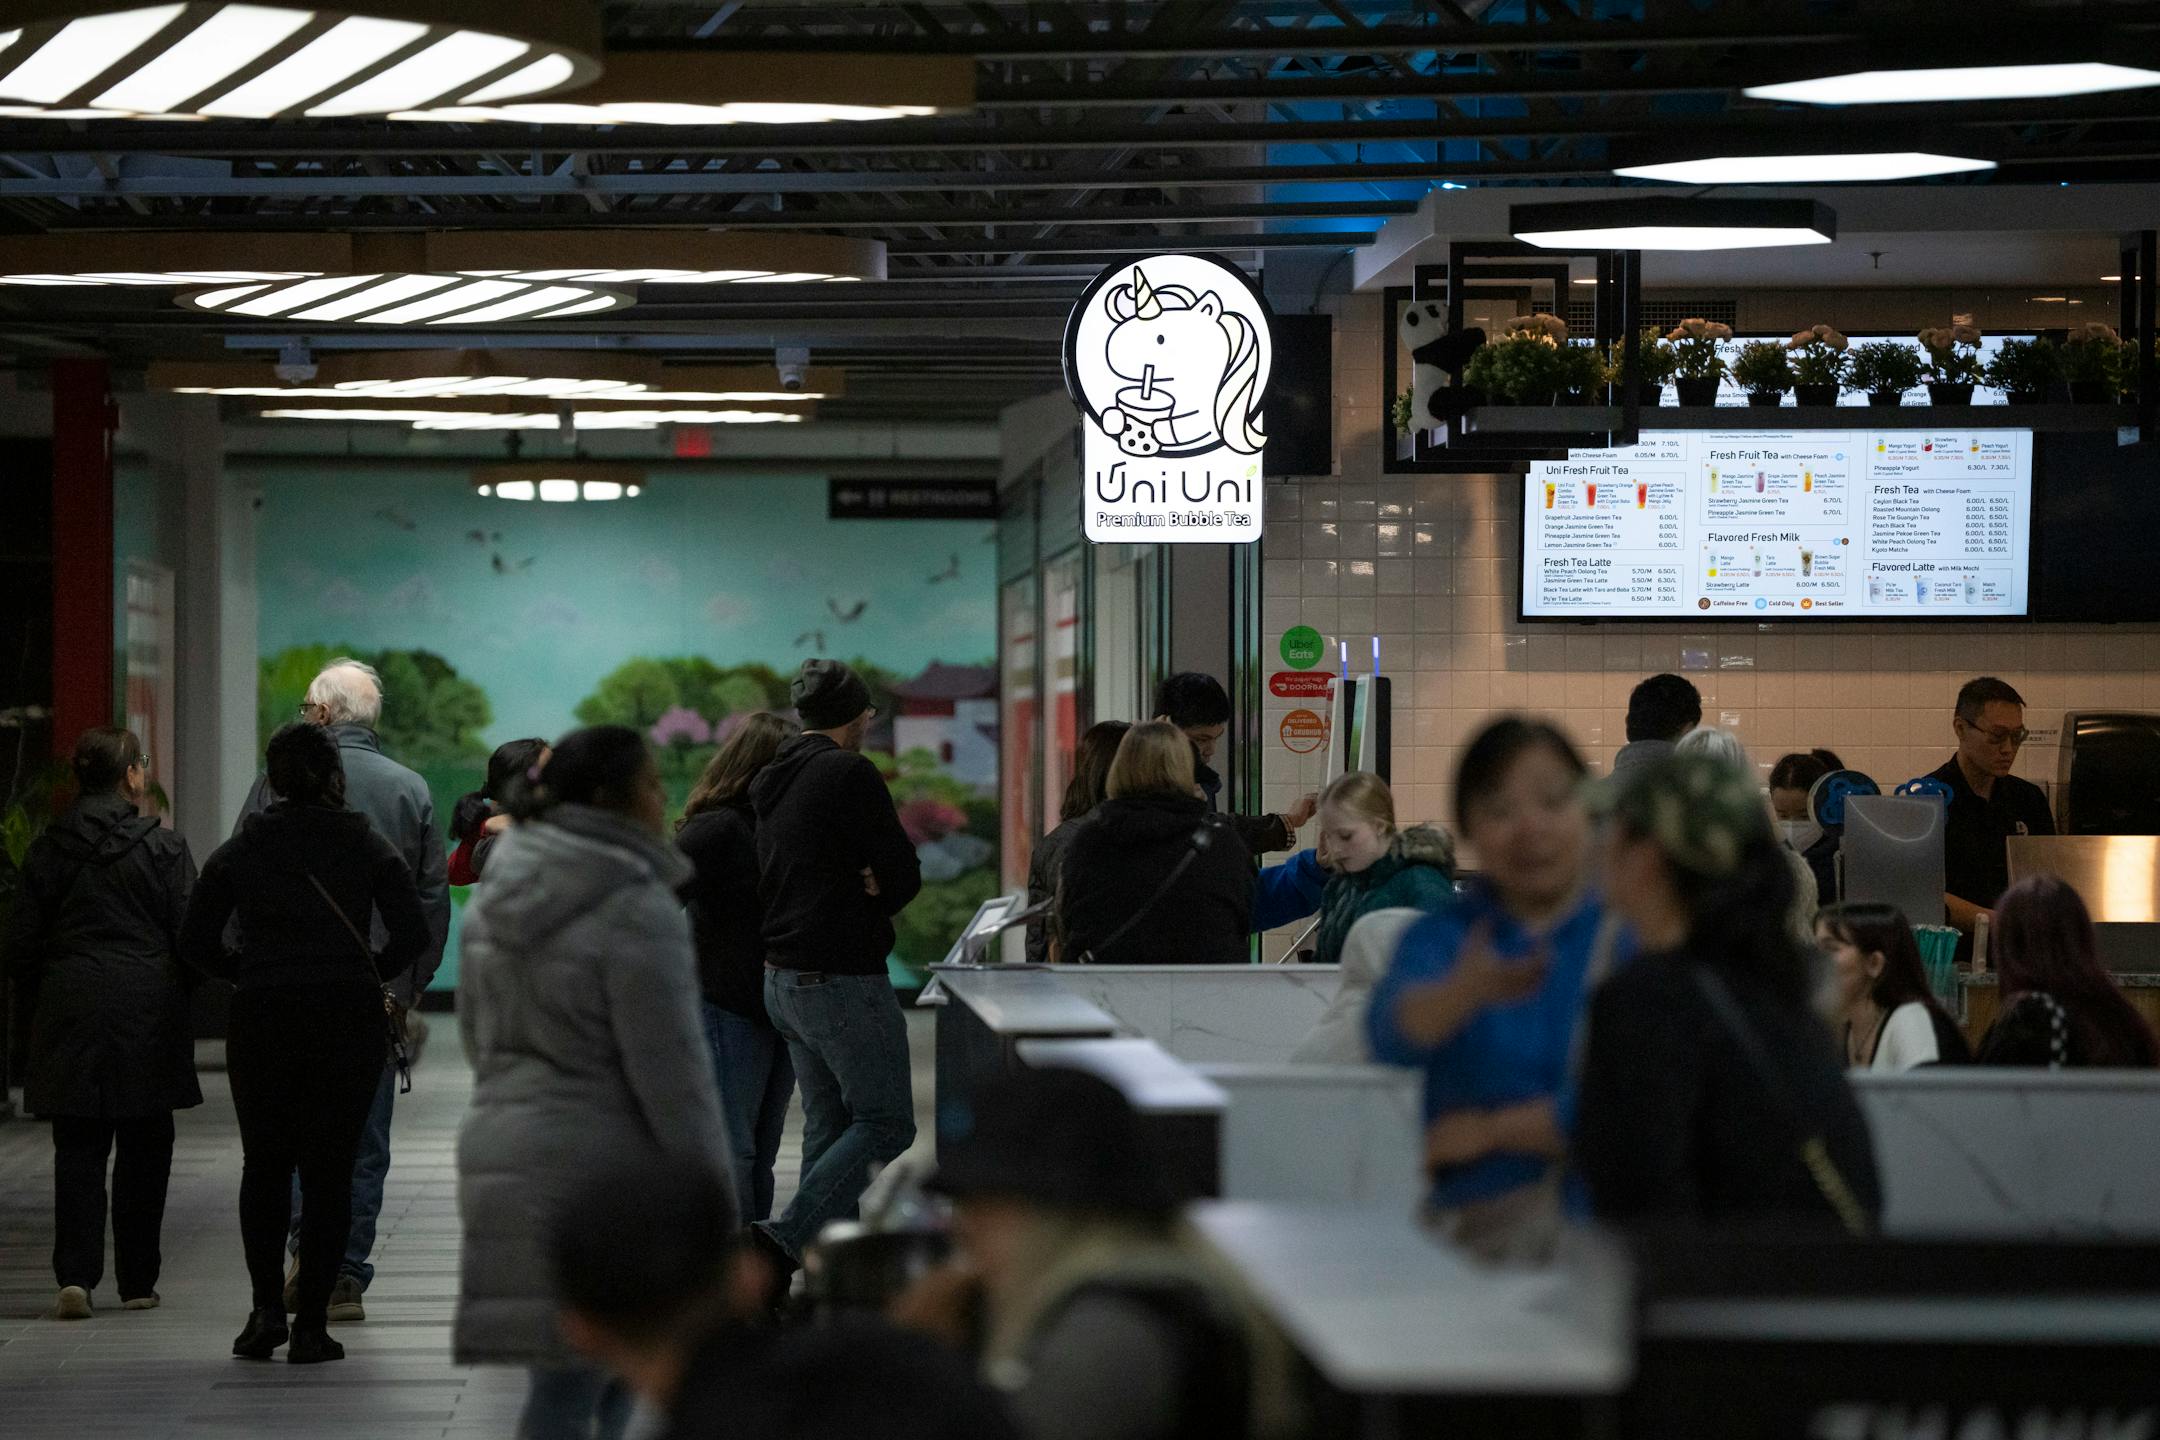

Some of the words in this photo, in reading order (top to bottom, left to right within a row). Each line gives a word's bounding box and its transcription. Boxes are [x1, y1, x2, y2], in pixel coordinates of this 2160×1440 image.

[1710, 450, 1736, 460] Fresh
[1738, 450, 1760, 460] Fruit
[1762, 450, 1779, 459] Tea
[1546, 466, 1561, 475] Uni
[1563, 466, 1588, 475] Fresh
[1590, 465, 1610, 475] Fruit
[1612, 465, 1629, 475] Tea
[1097, 461, 1166, 503] Uni
[1181, 464, 1257, 503] Uni
[1874, 485, 1901, 494] Fresh
[1903, 485, 1919, 494] Tea
[1096, 512, 1165, 527] Premium
[1169, 511, 1222, 526] Bubble
[1224, 512, 1251, 526] Tea
[1708, 533, 1749, 542] Flavored
[1751, 533, 1778, 542] Fresh
[1780, 533, 1800, 541] Milk
[1544, 558, 1569, 567] Fresh
[1571, 557, 1588, 567] Tea
[1589, 558, 1612, 567] Latte
[1872, 562, 1911, 572] Flavored
[1912, 563, 1935, 571] Latte
[1290, 640, 1313, 649] Uber
[1290, 650, 1314, 658] Eats
